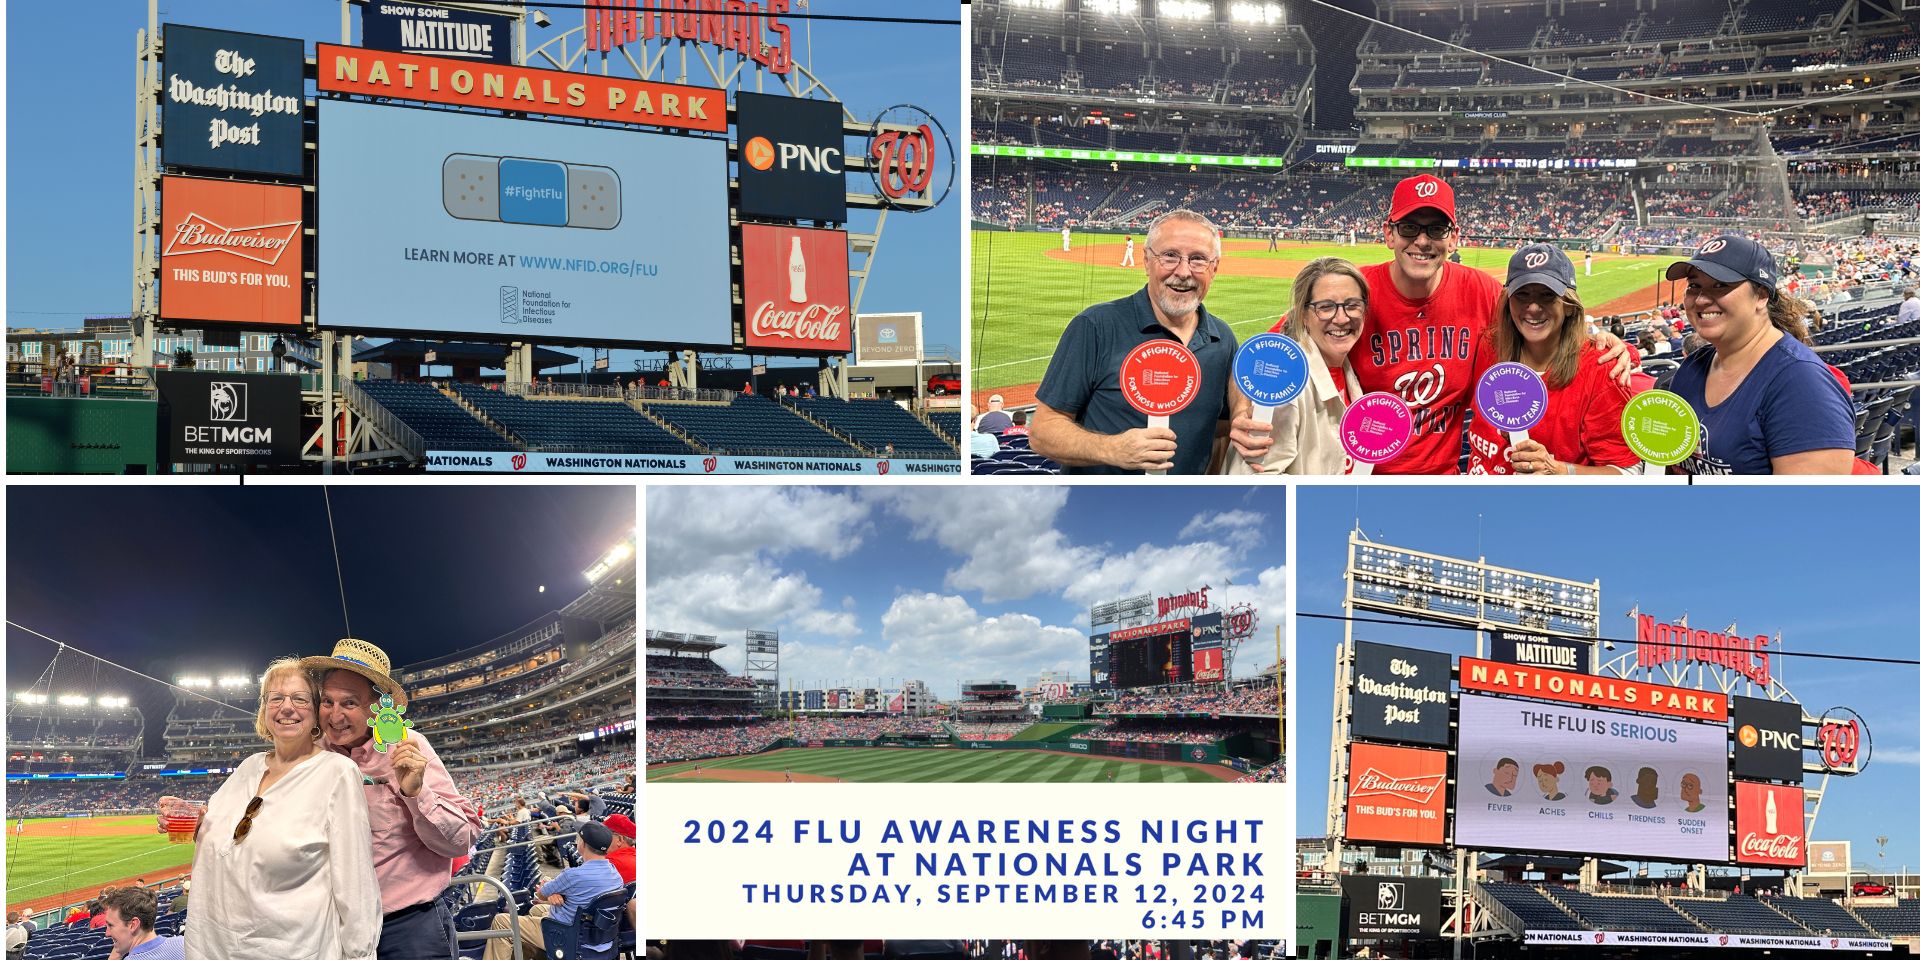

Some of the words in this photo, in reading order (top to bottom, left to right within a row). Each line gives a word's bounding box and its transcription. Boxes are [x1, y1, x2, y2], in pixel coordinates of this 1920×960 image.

[380, 5, 415, 16] SHOW
[418, 8, 448, 18] SOME
[401, 19, 492, 51] NATITUDE
[586, 0, 791, 74] NATIONALS
[215, 49, 256, 78] The
[169, 74, 300, 117] Washington
[336, 56, 586, 106] NATIONALS
[608, 87, 708, 120] PARK
[209, 118, 260, 149] Post
[777, 142, 841, 174] PNC
[504, 186, 563, 200] #FightFlu
[176, 224, 286, 250] Budweiser
[405, 248, 449, 262] LEARN
[453, 251, 494, 266] MORE
[498, 255, 515, 266] AT
[520, 255, 658, 277] WWW.NFID.ORG/FLU
[173, 269, 200, 281] THIS
[202, 270, 237, 284] BUD'S
[240, 272, 262, 285] FOR
[266, 274, 290, 288] YOU.
[523, 290, 551, 298] National
[523, 299, 560, 307] Foundation
[523, 307, 555, 315] Infectious
[523, 316, 552, 324] Diseases
[752, 301, 845, 340] Coca-Cola
[1141, 346, 1187, 363] #FIGHTFLU
[1255, 340, 1297, 360] #FIGHTFLU
[1370, 325, 1470, 367] SPRING
[700, 358, 733, 369] ACK
[1489, 367, 1530, 381] #FIGHTFLU
[1129, 377, 1137, 392] FOR
[1134, 391, 1155, 409] THOSE
[1157, 400, 1176, 410] WHO
[1177, 376, 1194, 402] CANNOT
[1241, 375, 1254, 391] FOR
[1254, 389, 1268, 399] MY
[1270, 382, 1296, 400] FAMILY
[1366, 398, 1406, 418] #FIGHTFLU
[1488, 406, 1504, 422] FOR
[1507, 417, 1520, 425] MY
[1522, 400, 1541, 422] TEAM
[1642, 396, 1686, 417] #FIGHTFLU
[185, 425, 272, 443] BETMGM
[1628, 416, 1636, 431] FOR
[1348, 430, 1358, 447] FOR
[1356, 445, 1370, 456] MY
[1372, 438, 1401, 457] HEALTH
[1470, 431, 1499, 459] KEEP
[1631, 433, 1669, 459] COMMUNITY
[1670, 425, 1692, 457] IMMUNITY
[425, 456, 492, 466] NATIONALS
[546, 457, 622, 468] WASHINGTON
[625, 458, 686, 469] NATIONALS
[734, 461, 803, 470] WASHINGTON
[806, 461, 861, 472] NATIONALS
[1158, 586, 1208, 617] NATIONALS
[1112, 626, 1158, 639] NATIONALS
[1161, 621, 1185, 631] PARK
[1202, 625, 1220, 634] PNC
[1503, 633, 1526, 641] SHOW
[1528, 635, 1548, 643] SOME
[1516, 642, 1577, 666] NATITUDE
[1638, 614, 1769, 686] NATIONALS
[1389, 659, 1418, 678] The
[1358, 674, 1447, 705] Washington
[1472, 665, 1638, 702] NATIONALS
[1652, 691, 1716, 714] PARK
[1384, 705, 1420, 725] Post
[1521, 710, 1552, 728] THE
[1558, 716, 1586, 733] FLU
[1592, 720, 1606, 735] IS
[1610, 721, 1677, 743] SERIOUS
[1760, 729, 1800, 750] PNC
[1359, 774, 1436, 794] Budweiser
[1355, 805, 1374, 816] THIS
[1376, 806, 1400, 817] BUD'S
[1402, 808, 1417, 818] FOR
[1419, 809, 1437, 819] YOU.
[1488, 803, 1512, 812] FEVER
[1539, 807, 1566, 816] ACHES
[1588, 811, 1614, 820] CHILLS
[1628, 815, 1666, 824] TIREDNESS
[1678, 818, 1706, 827] SUDDEN
[1680, 826, 1703, 834] ONSET
[1741, 832, 1802, 859] Coca-Cola
[1359, 912, 1421, 925] BETMGM
